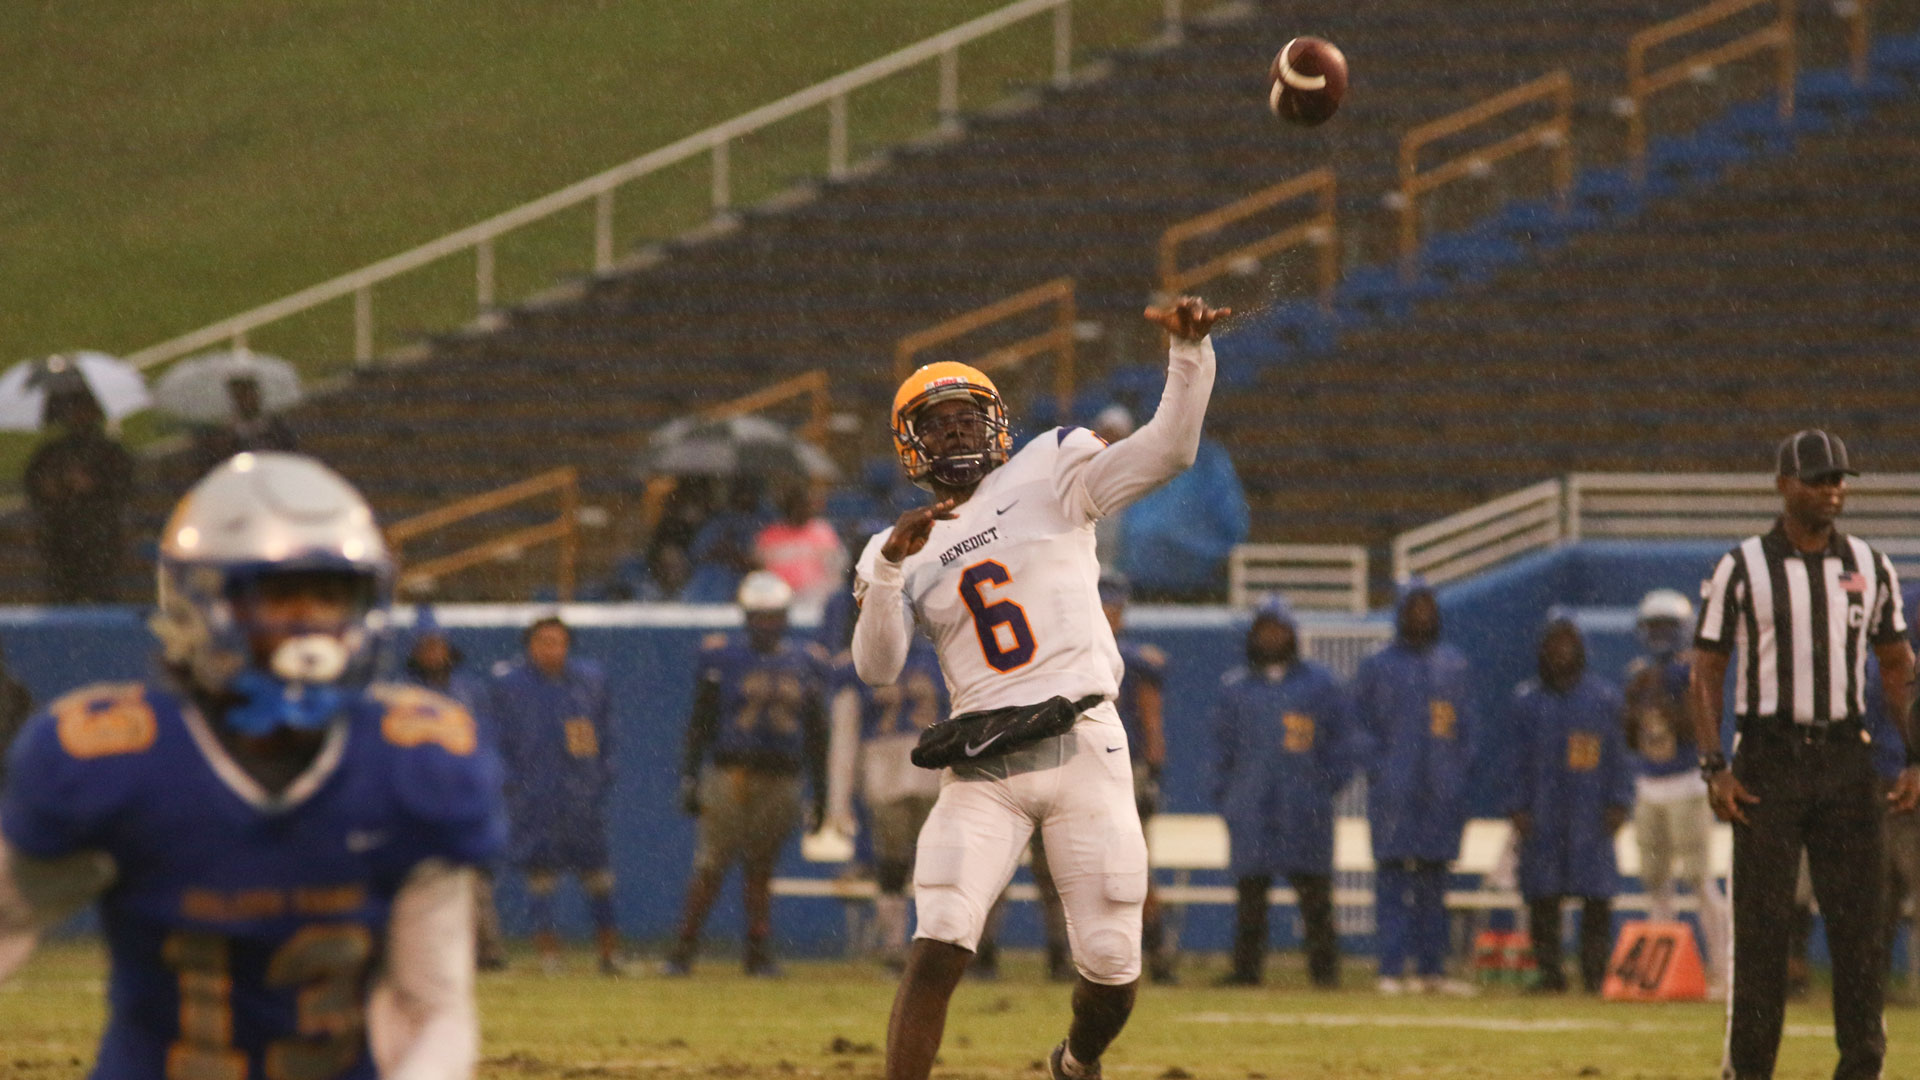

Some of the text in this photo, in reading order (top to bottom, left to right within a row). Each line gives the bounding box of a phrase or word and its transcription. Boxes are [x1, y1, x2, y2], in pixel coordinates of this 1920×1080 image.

[939, 526, 999, 567] BENEDICT
[958, 558, 1039, 674] 6
[1615, 936, 1676, 990] 40
